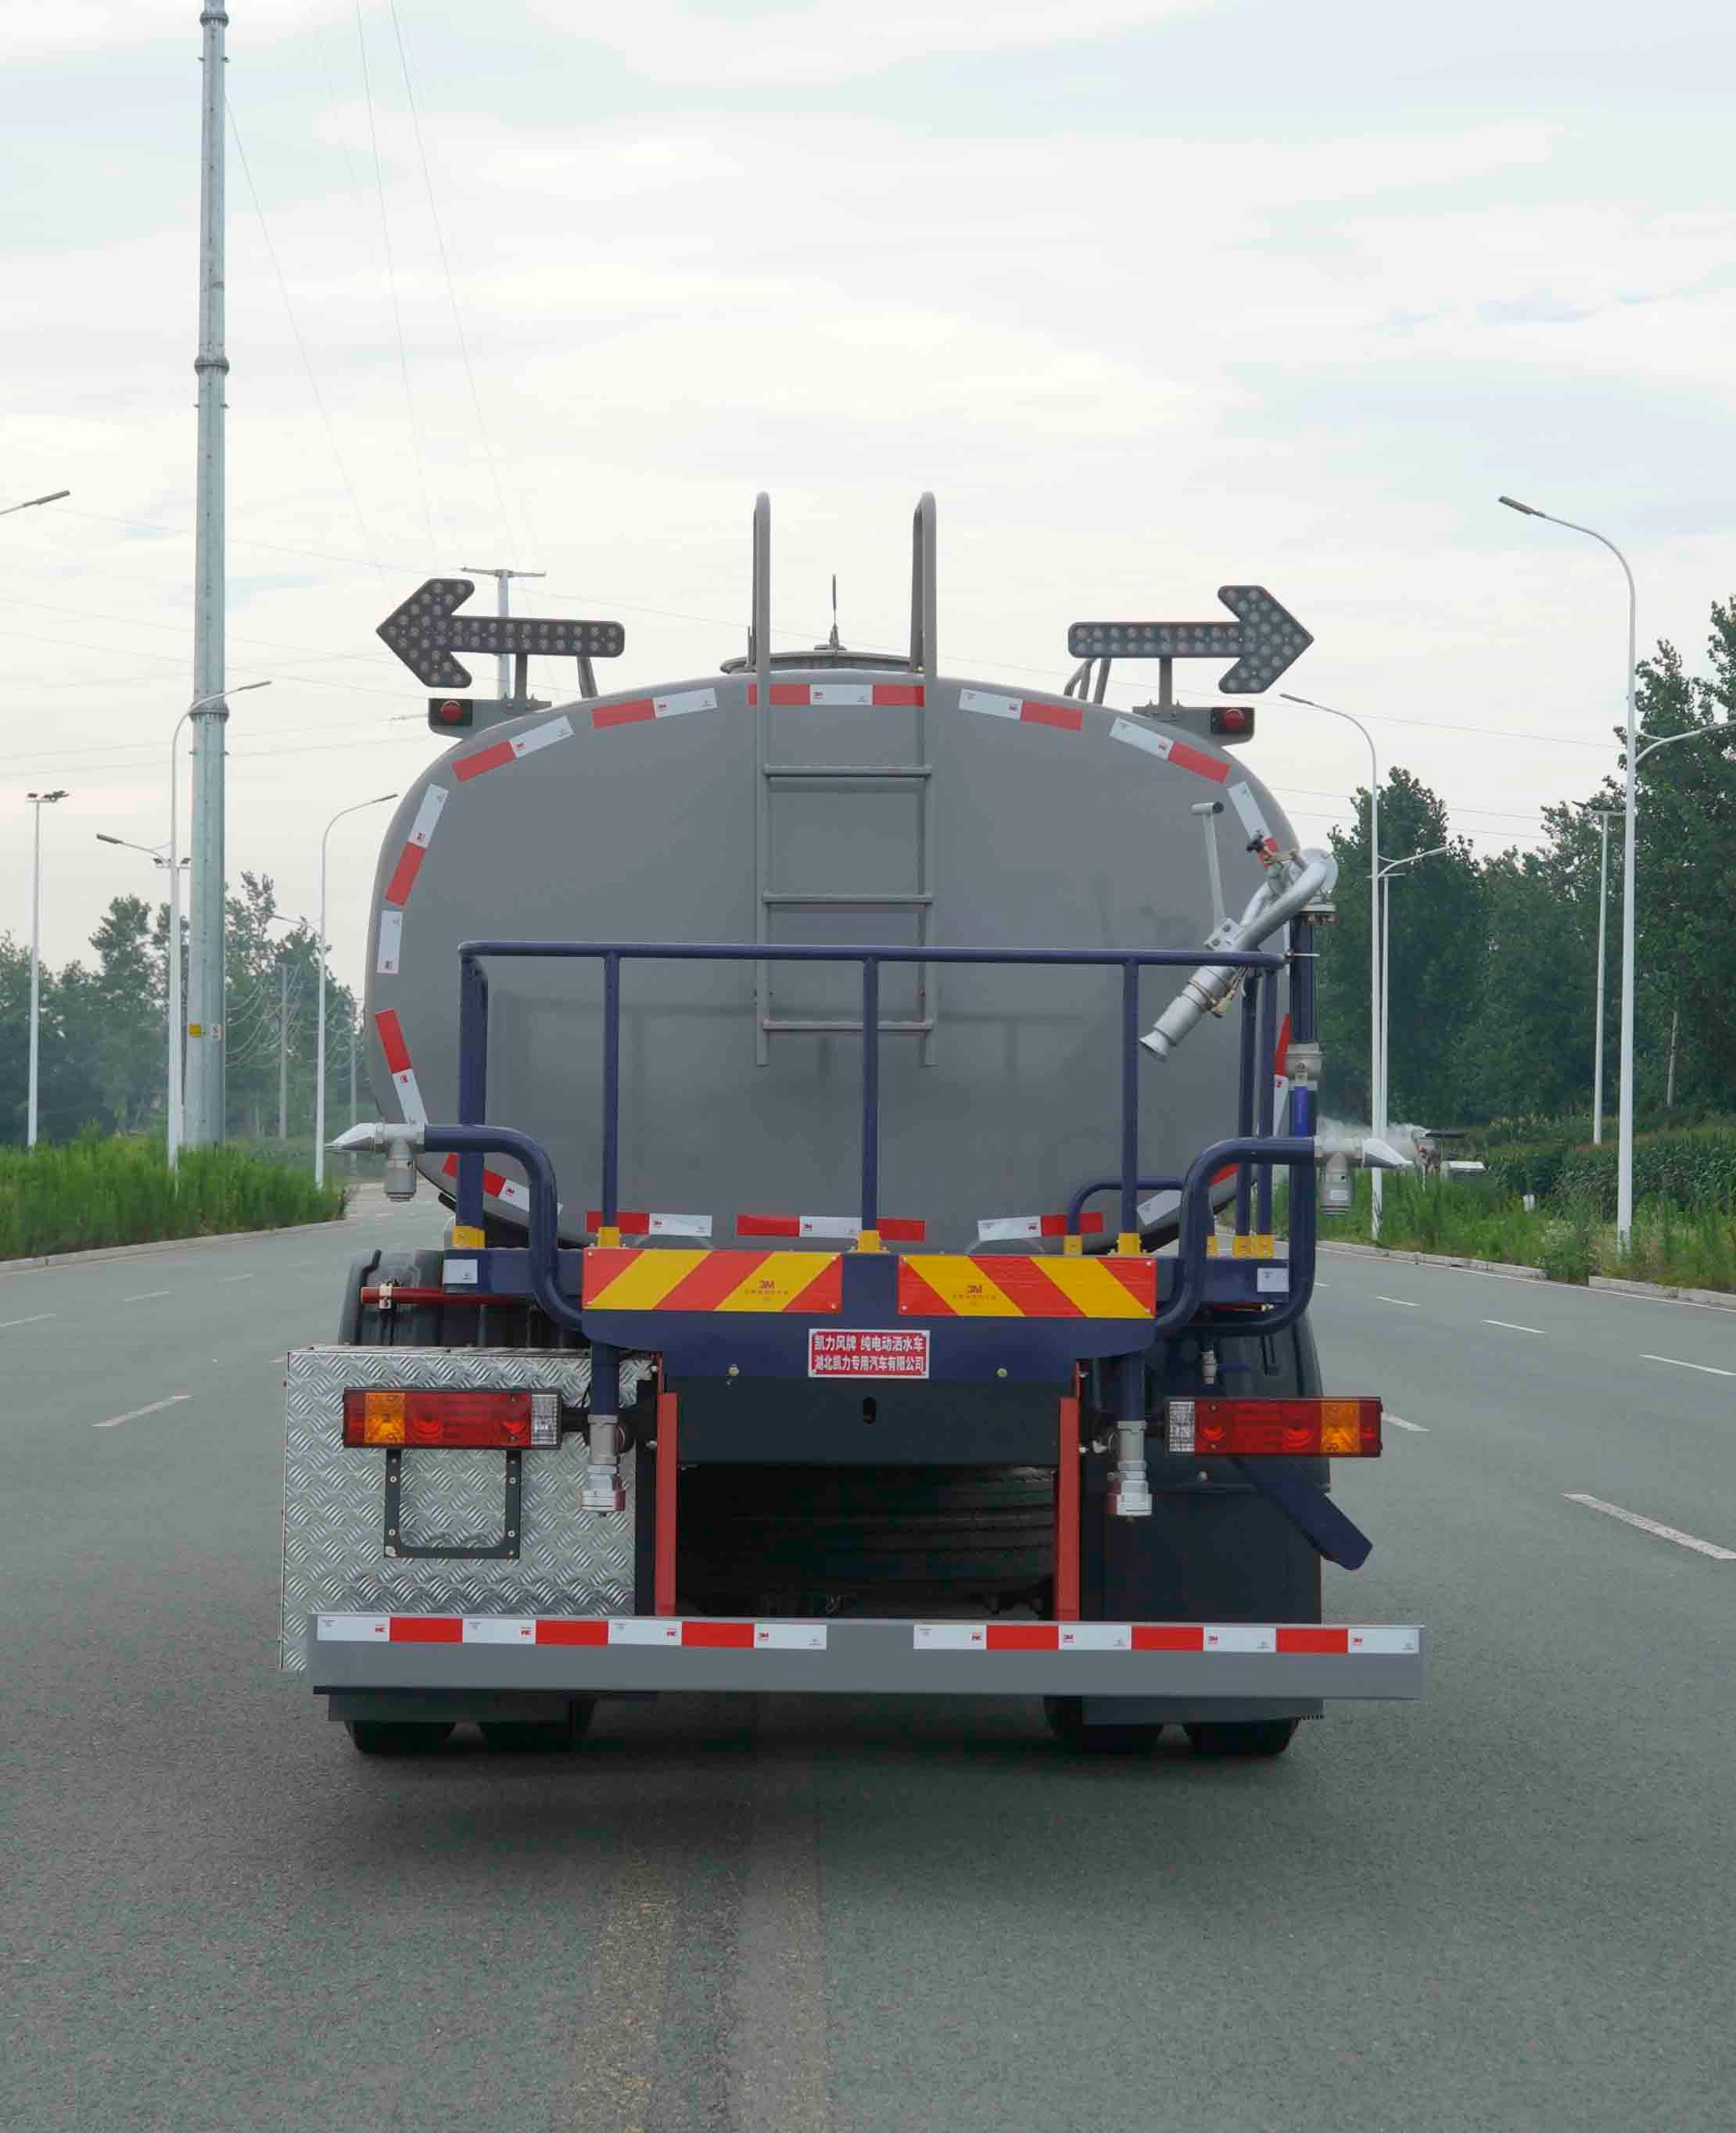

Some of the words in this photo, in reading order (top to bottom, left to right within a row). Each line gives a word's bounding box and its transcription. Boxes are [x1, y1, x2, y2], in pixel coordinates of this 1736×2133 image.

[759, 1280, 775, 1289] 3M
[967, 1285, 982, 1294] 3M
[814, 1335, 856, 1351] 凯力风牌
[860, 1335, 924, 1352] 纯电动洒水车
[814, 1354, 924, 1371] 湖北凯力专用汽车有限公司
